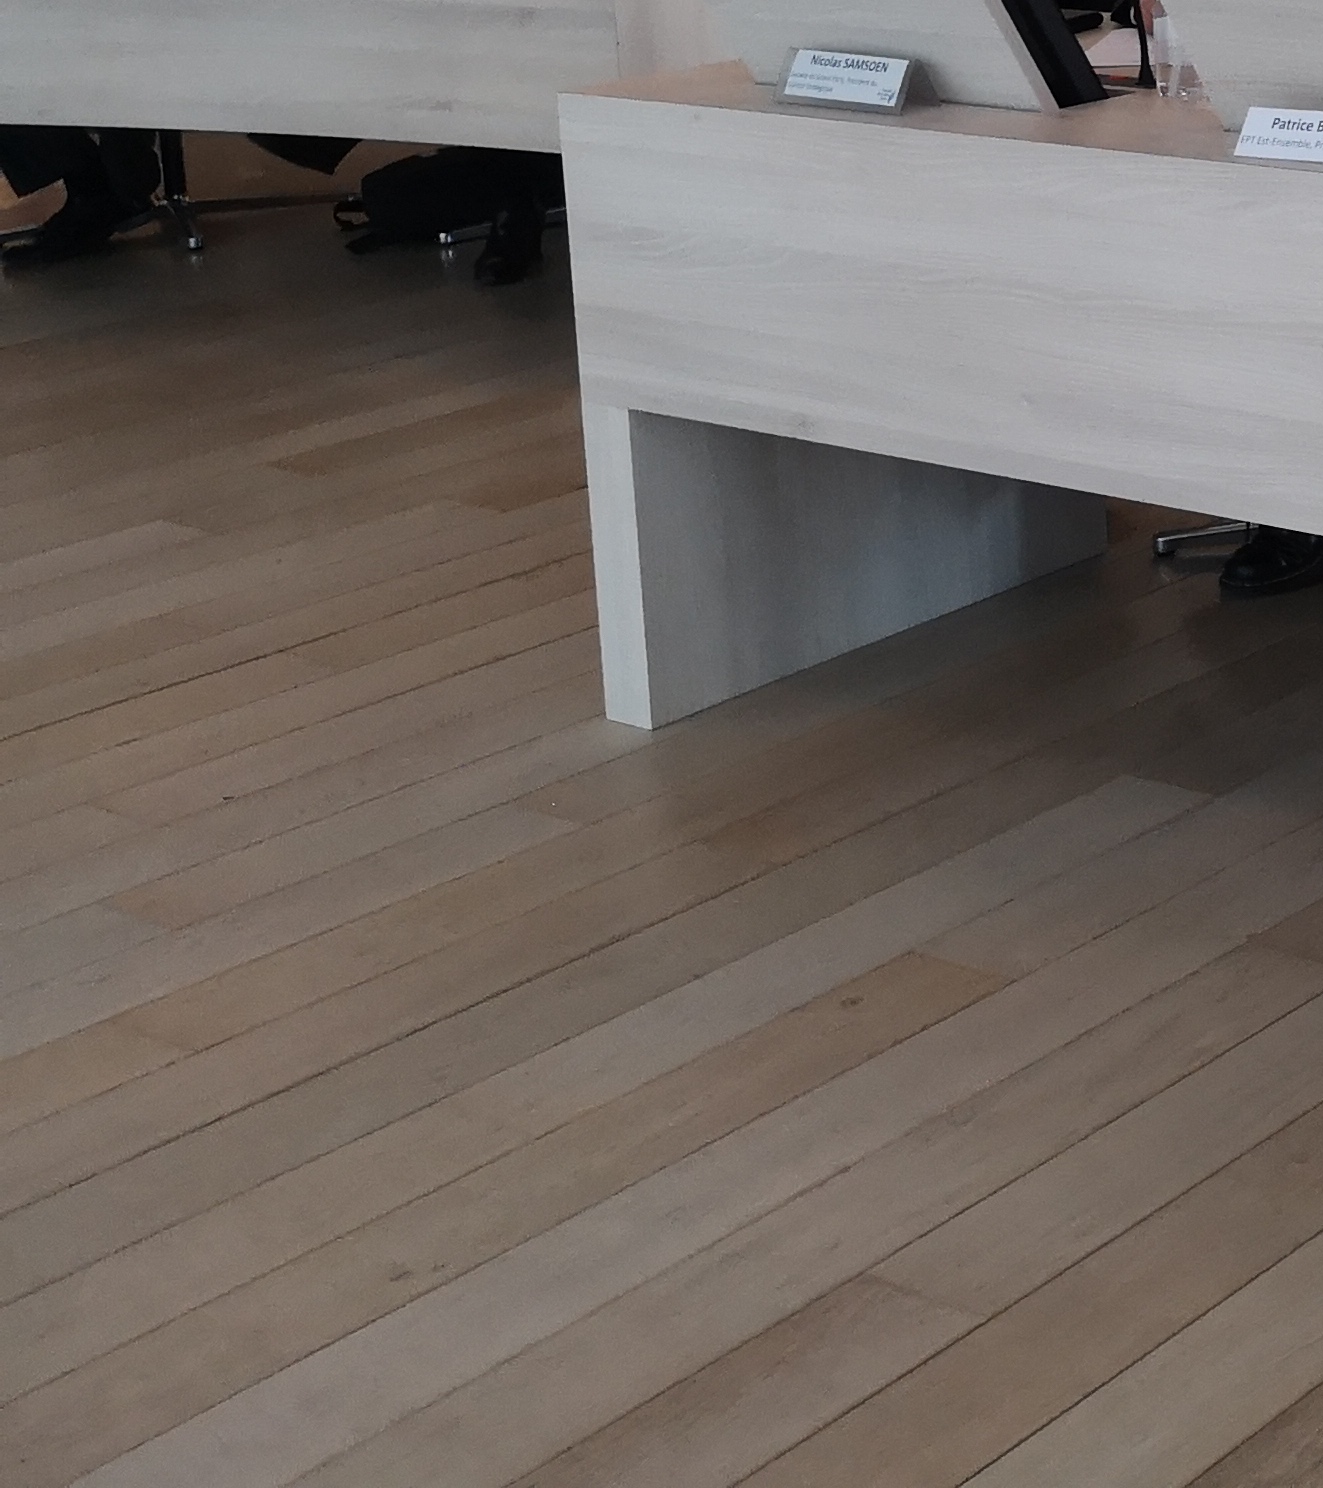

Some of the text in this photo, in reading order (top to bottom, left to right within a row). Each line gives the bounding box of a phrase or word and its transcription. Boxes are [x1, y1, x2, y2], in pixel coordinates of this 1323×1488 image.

[810, 54, 890, 73] Nicolas SAMSOEN
[1271, 117, 1314, 132] Patrice
